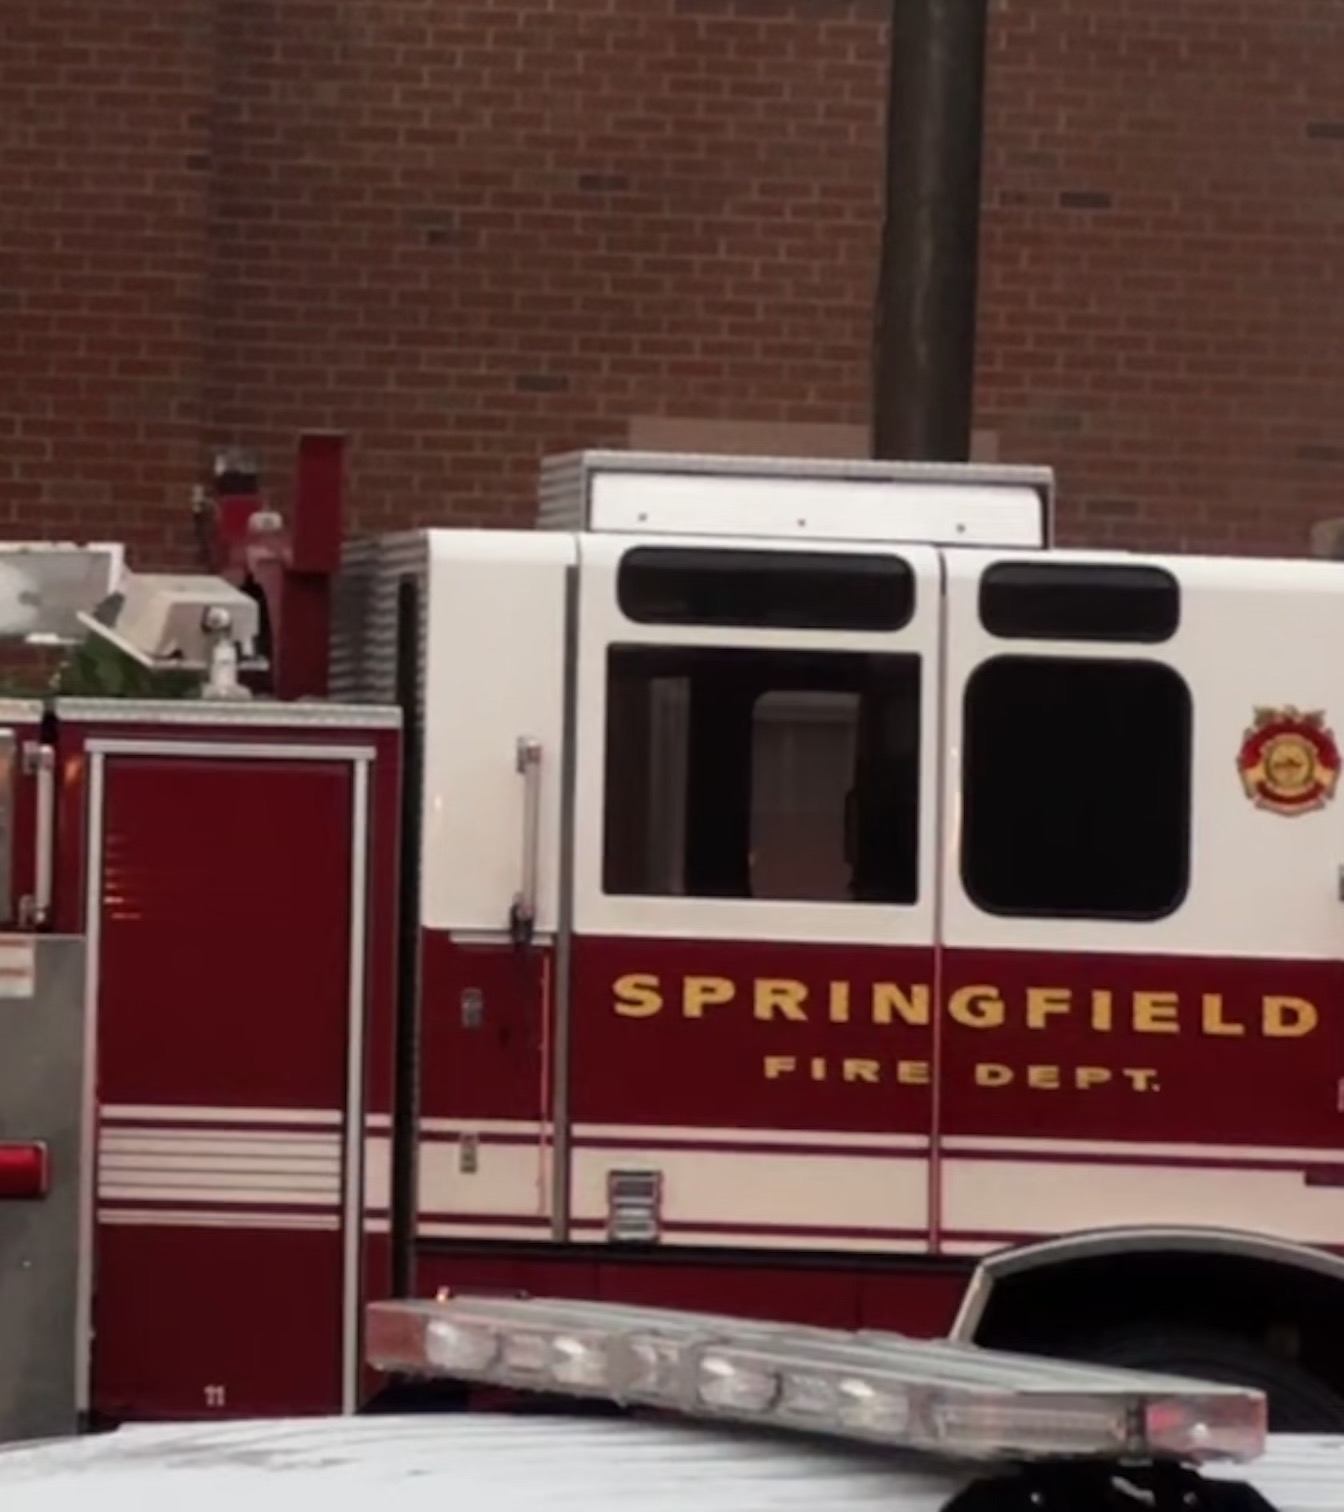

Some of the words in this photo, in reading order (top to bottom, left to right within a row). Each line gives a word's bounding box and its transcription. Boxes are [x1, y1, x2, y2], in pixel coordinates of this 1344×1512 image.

[612, 973, 1319, 1038] SPRINGFIELD
[763, 1055, 931, 1085] FIRE
[974, 1062, 1162, 1092] DEPT.
